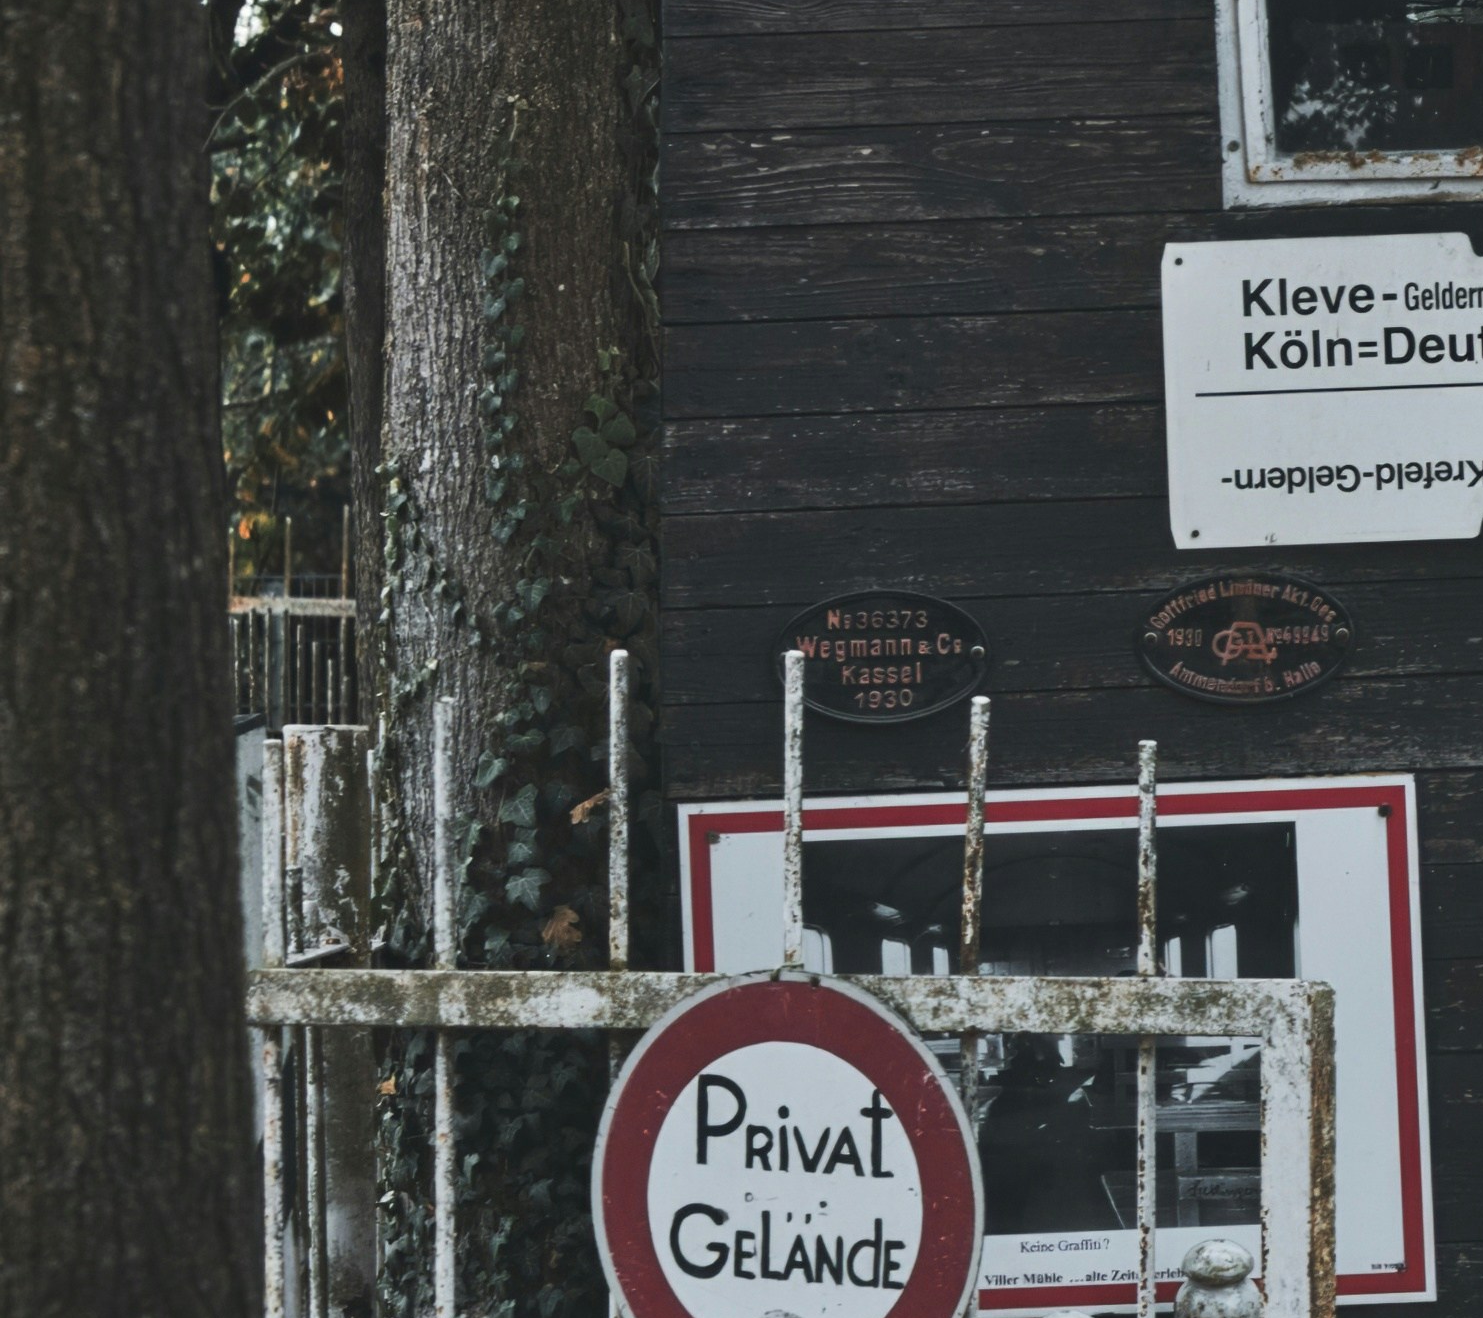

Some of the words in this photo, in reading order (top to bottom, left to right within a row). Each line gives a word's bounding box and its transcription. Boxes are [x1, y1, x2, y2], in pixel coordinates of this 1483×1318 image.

[796, 635, 912, 663] Wegmann
[841, 661, 923, 686] Kassel
[854, 688, 914, 709] 1930
[1021, 1241, 1054, 1253] Keine
[984, 1274, 1019, 1286] Viller
[1023, 1273, 1063, 1285] Mühle
